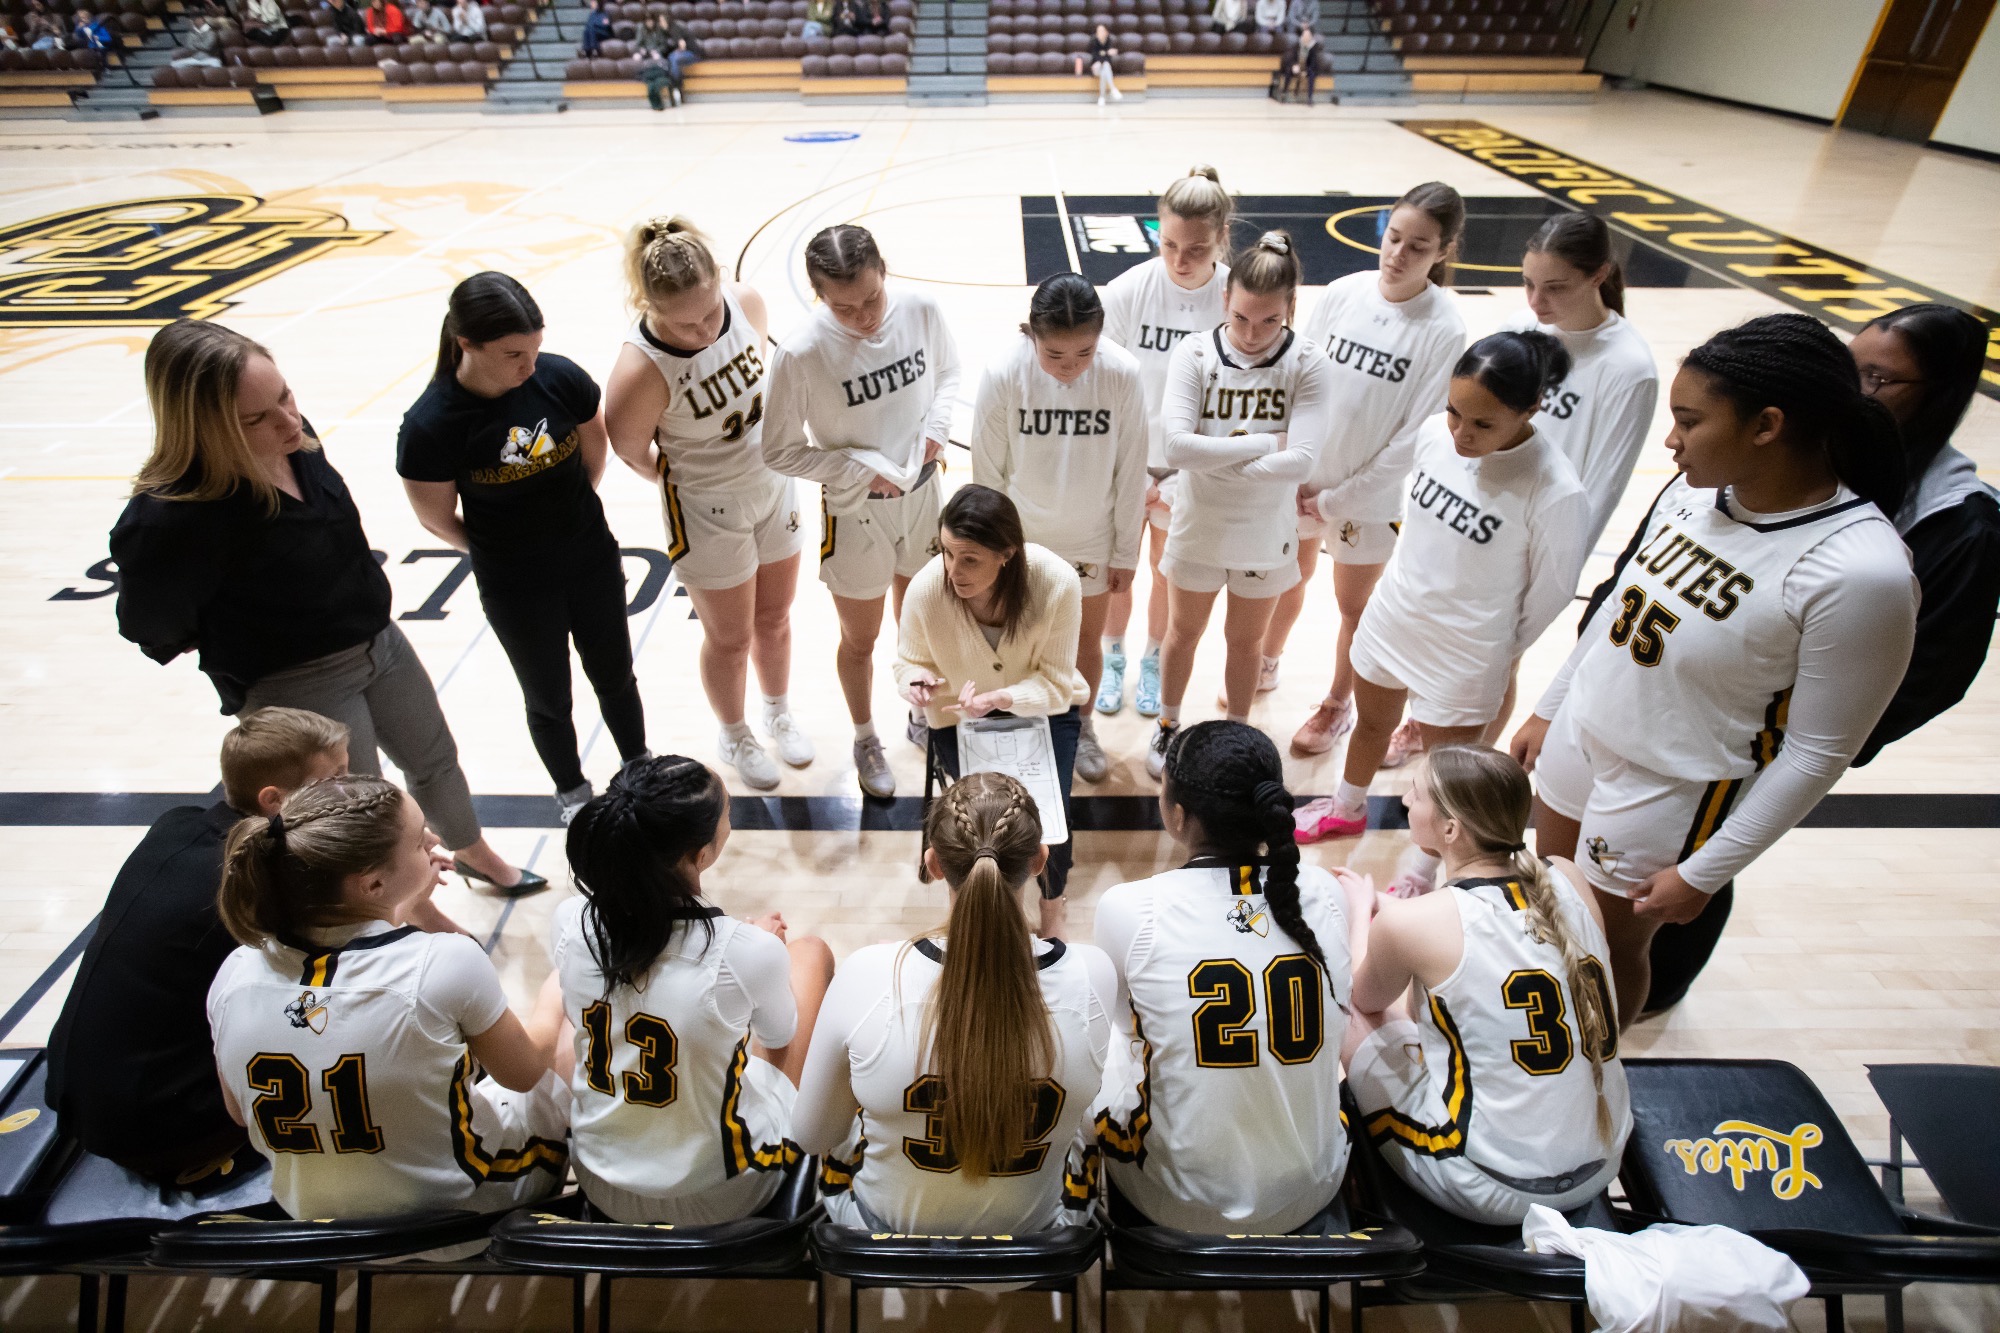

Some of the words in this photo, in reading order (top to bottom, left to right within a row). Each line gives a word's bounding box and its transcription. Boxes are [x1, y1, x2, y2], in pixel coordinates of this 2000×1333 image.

[1422, 128, 1675, 204] PACIFIC
[684, 344, 764, 420] LUTES
[842, 349, 926, 408] LUTES
[1325, 334, 1411, 383] LUTES
[1019, 408, 1111, 436] LUTES
[1201, 387, 1286, 421] LUTES
[1410, 470, 1502, 545] LUTES
[1634, 523, 1753, 621] LUTES
[1609, 584, 1682, 667] 35
[1188, 954, 1324, 1068] 20
[1501, 954, 1619, 1076] 30
[582, 1000, 678, 1107] 13
[246, 1052, 386, 1154] 21
[1664, 1120, 1823, 1200] Lutes
